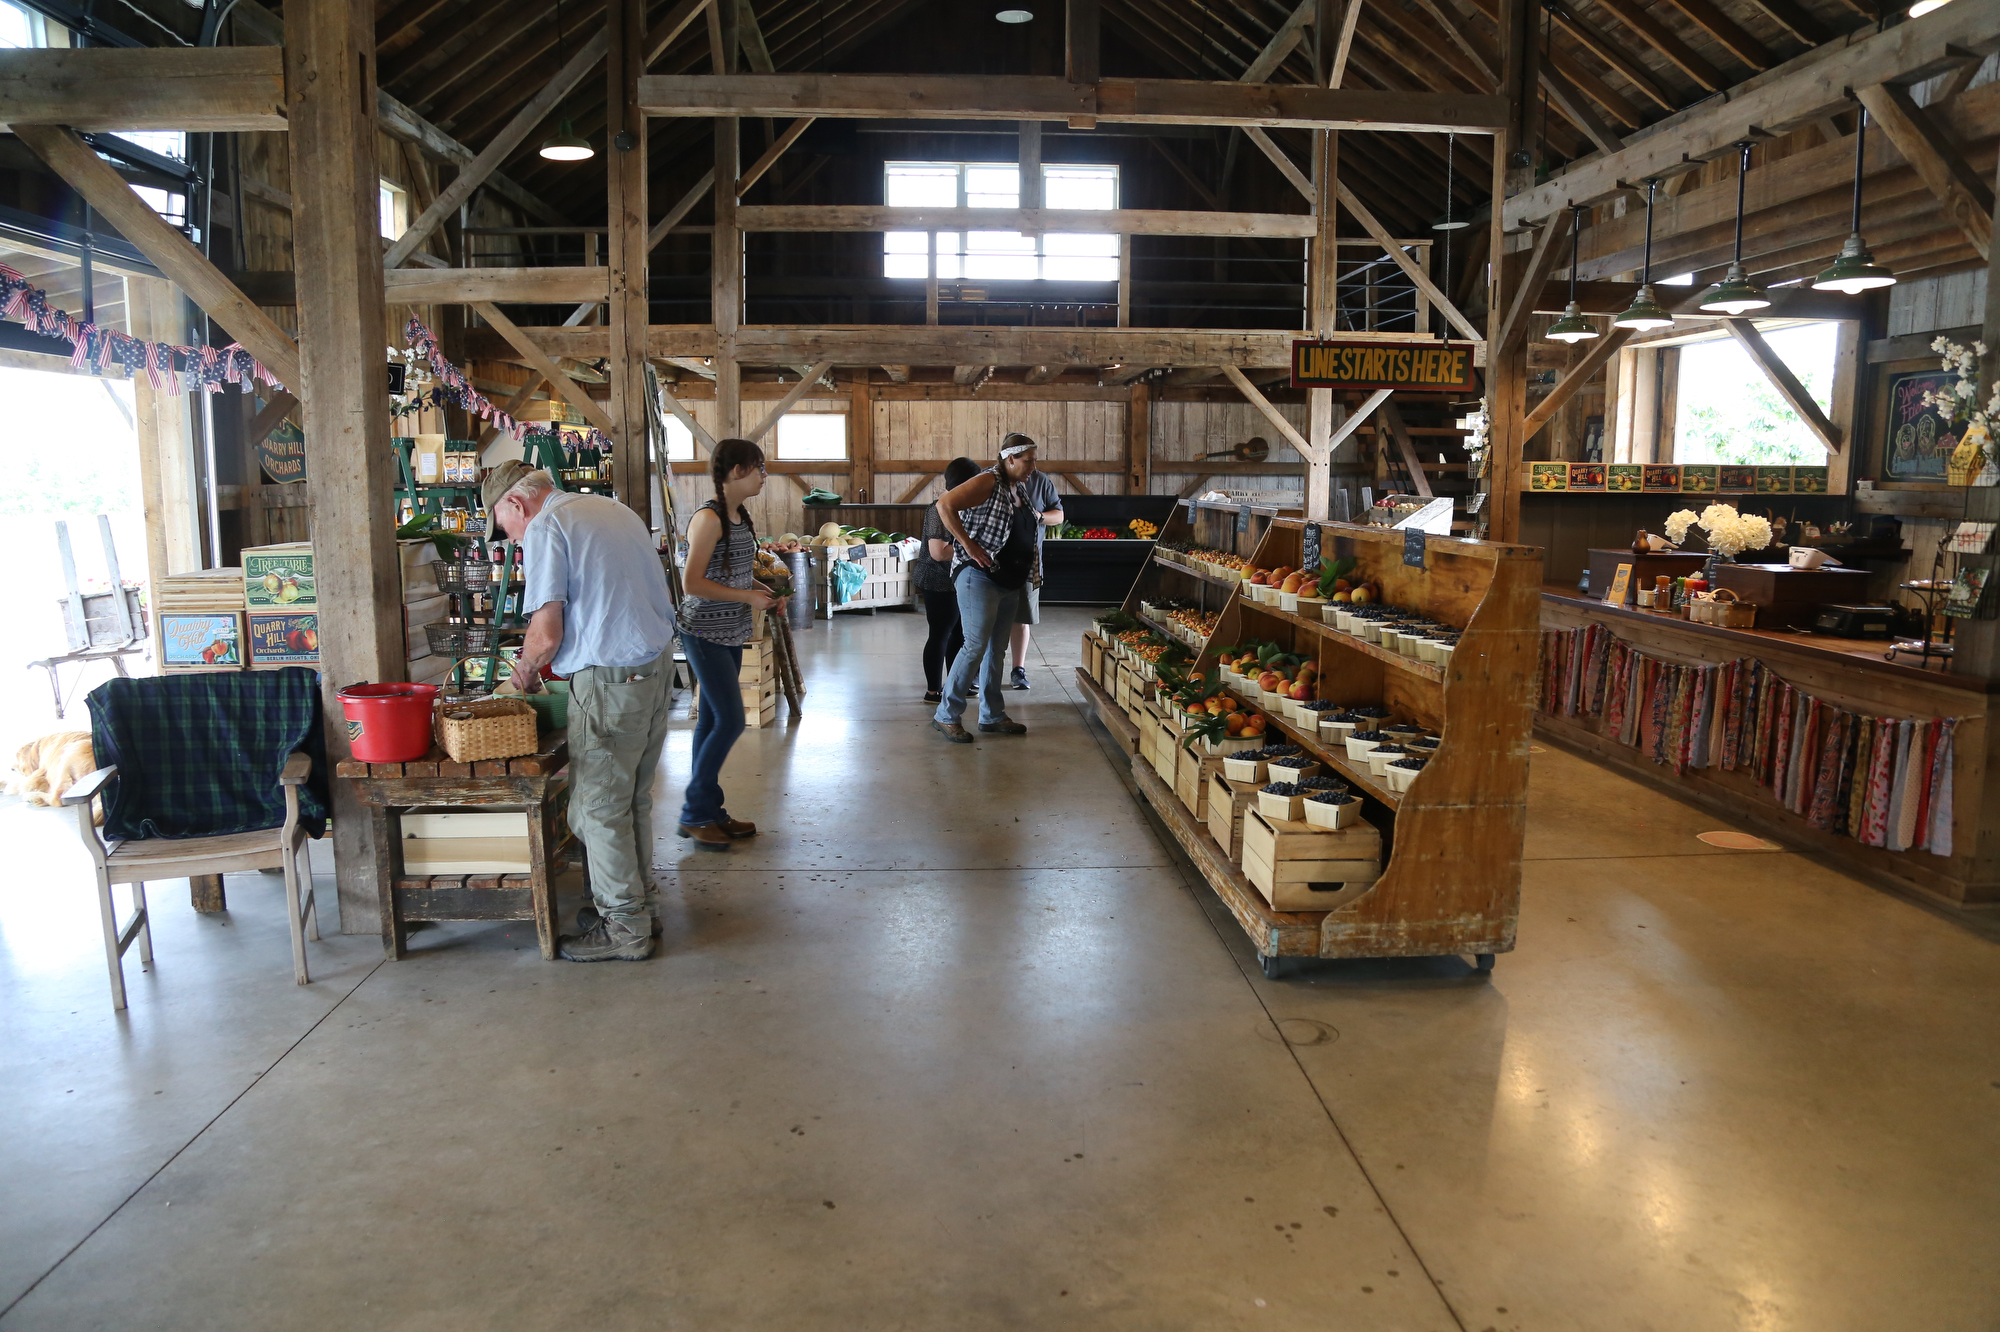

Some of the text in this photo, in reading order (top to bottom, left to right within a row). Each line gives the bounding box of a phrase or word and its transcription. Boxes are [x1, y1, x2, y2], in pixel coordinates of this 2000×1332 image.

[1298, 347, 1467, 384] LINE STARTS HERE
[288, 442, 304, 456] HILL
[264, 454, 302, 475] ORCHARDS
[251, 558, 280, 572] TREE
[282, 559, 308, 572] TABLE
[166, 619, 215, 639] Quarry
[253, 620, 286, 639] QUARRY
[178, 631, 207, 651] Hill
[266, 631, 287, 648] HILL
